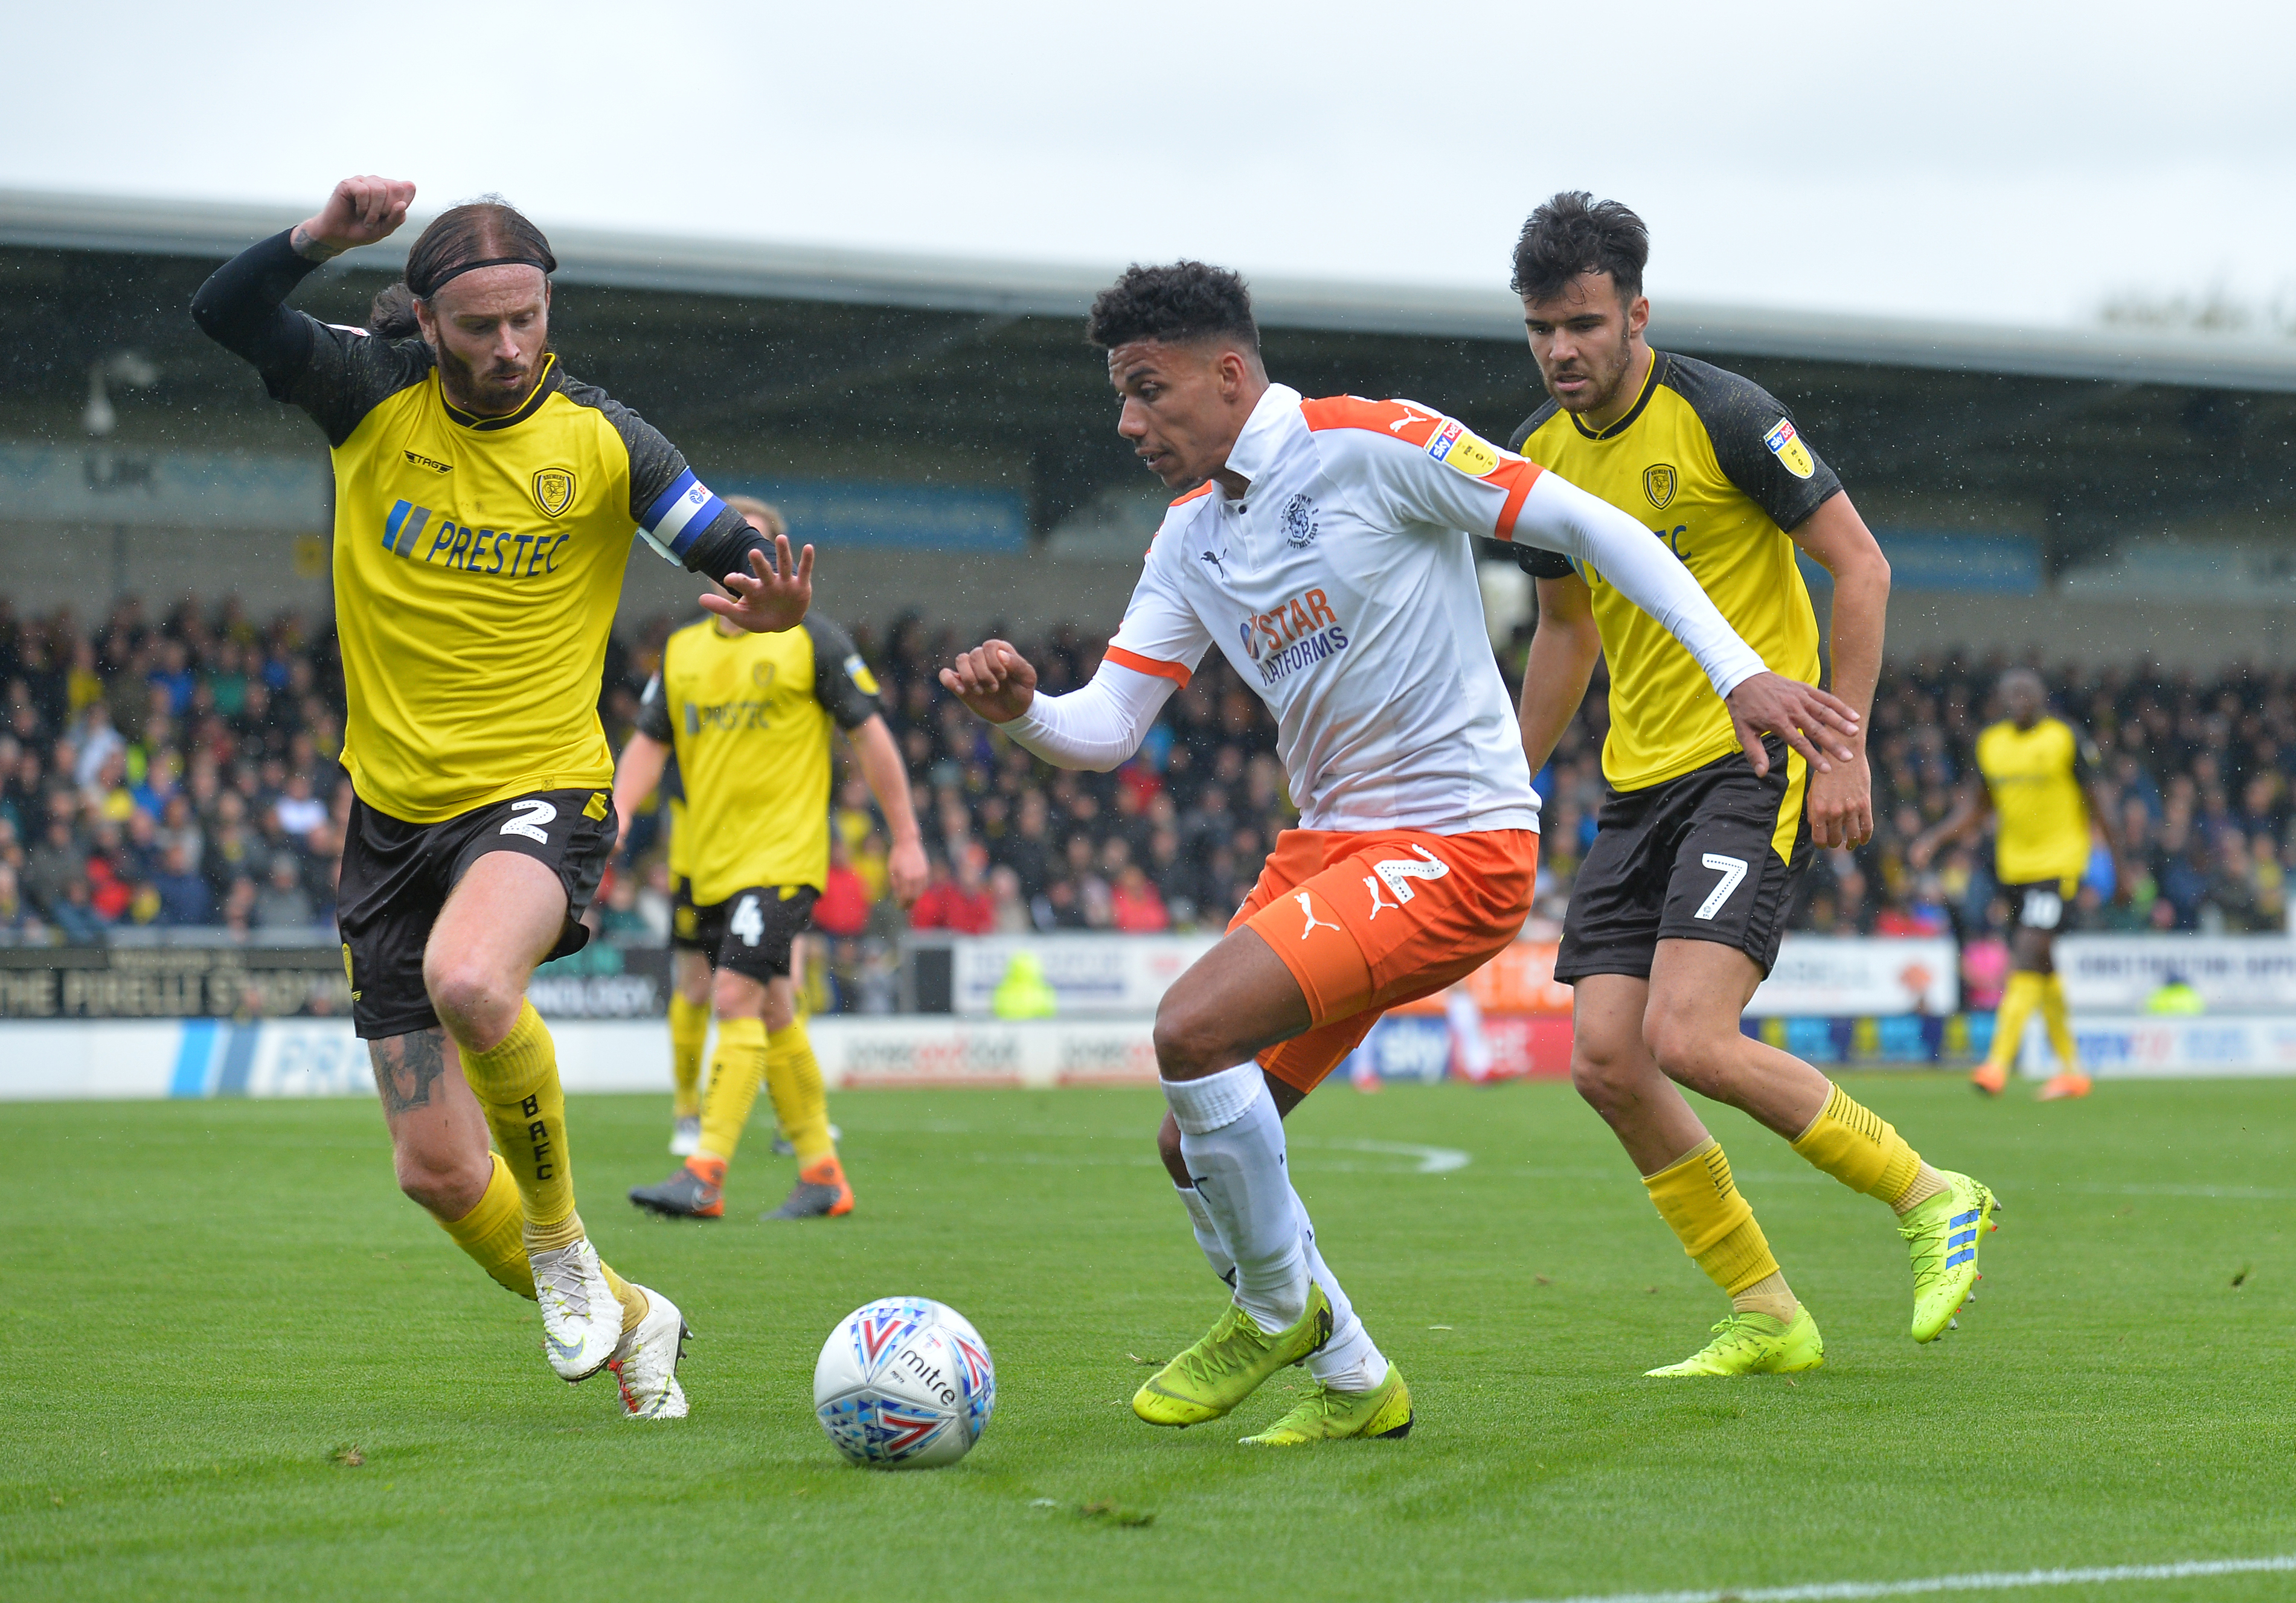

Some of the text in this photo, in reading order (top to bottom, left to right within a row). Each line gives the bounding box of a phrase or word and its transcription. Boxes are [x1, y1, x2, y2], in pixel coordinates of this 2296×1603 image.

[415, 455, 440, 469] TAG
[1433, 423, 1461, 458] sky bet
[1771, 424, 1793, 449] sky bet
[426, 520, 570, 577] PRESTEC
[1259, 589, 1337, 651] STAR
[499, 799, 557, 845] 2
[1373, 843, 1451, 904] 2
[1693, 853, 1749, 920] 7
[730, 894, 765, 947] 4
[521, 1093, 553, 1181] BAFC
[901, 1350, 955, 1406] mitre
